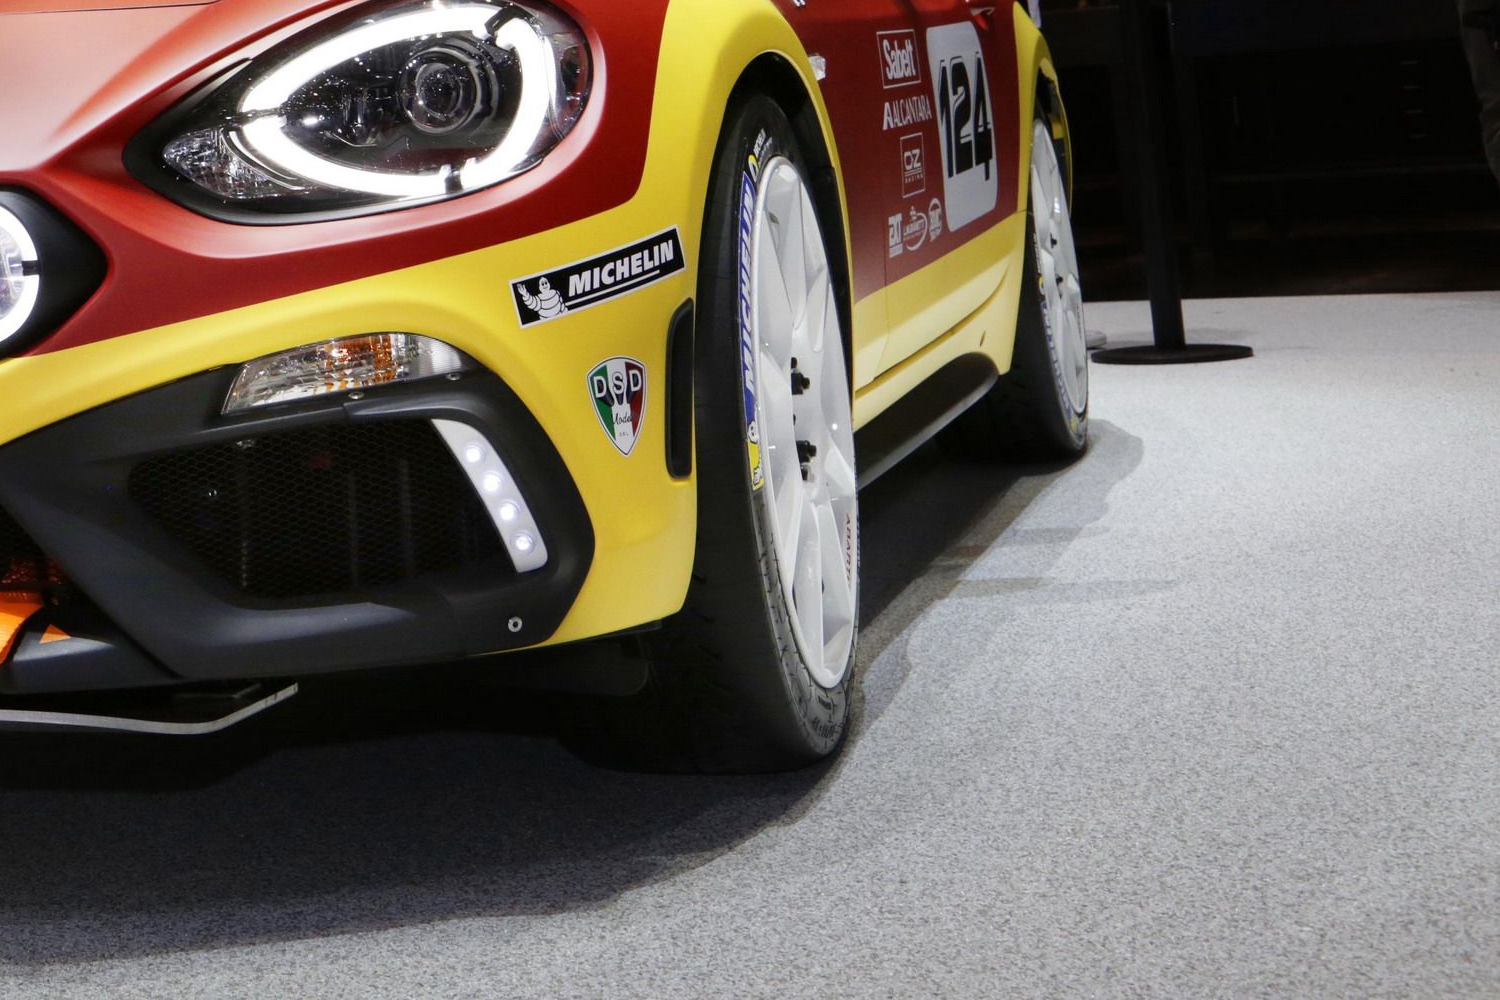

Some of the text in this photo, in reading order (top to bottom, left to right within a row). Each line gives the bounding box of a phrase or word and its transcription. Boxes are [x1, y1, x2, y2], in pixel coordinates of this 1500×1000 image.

[882, 38, 916, 80] Sabelt
[892, 94, 933, 128] ALCANTARA
[937, 50, 992, 182] 124
[903, 148, 922, 170] OZ
[568, 239, 674, 298] MICHELIN
[741, 181, 756, 398] MICHELIN
[593, 369, 642, 399] DSD
